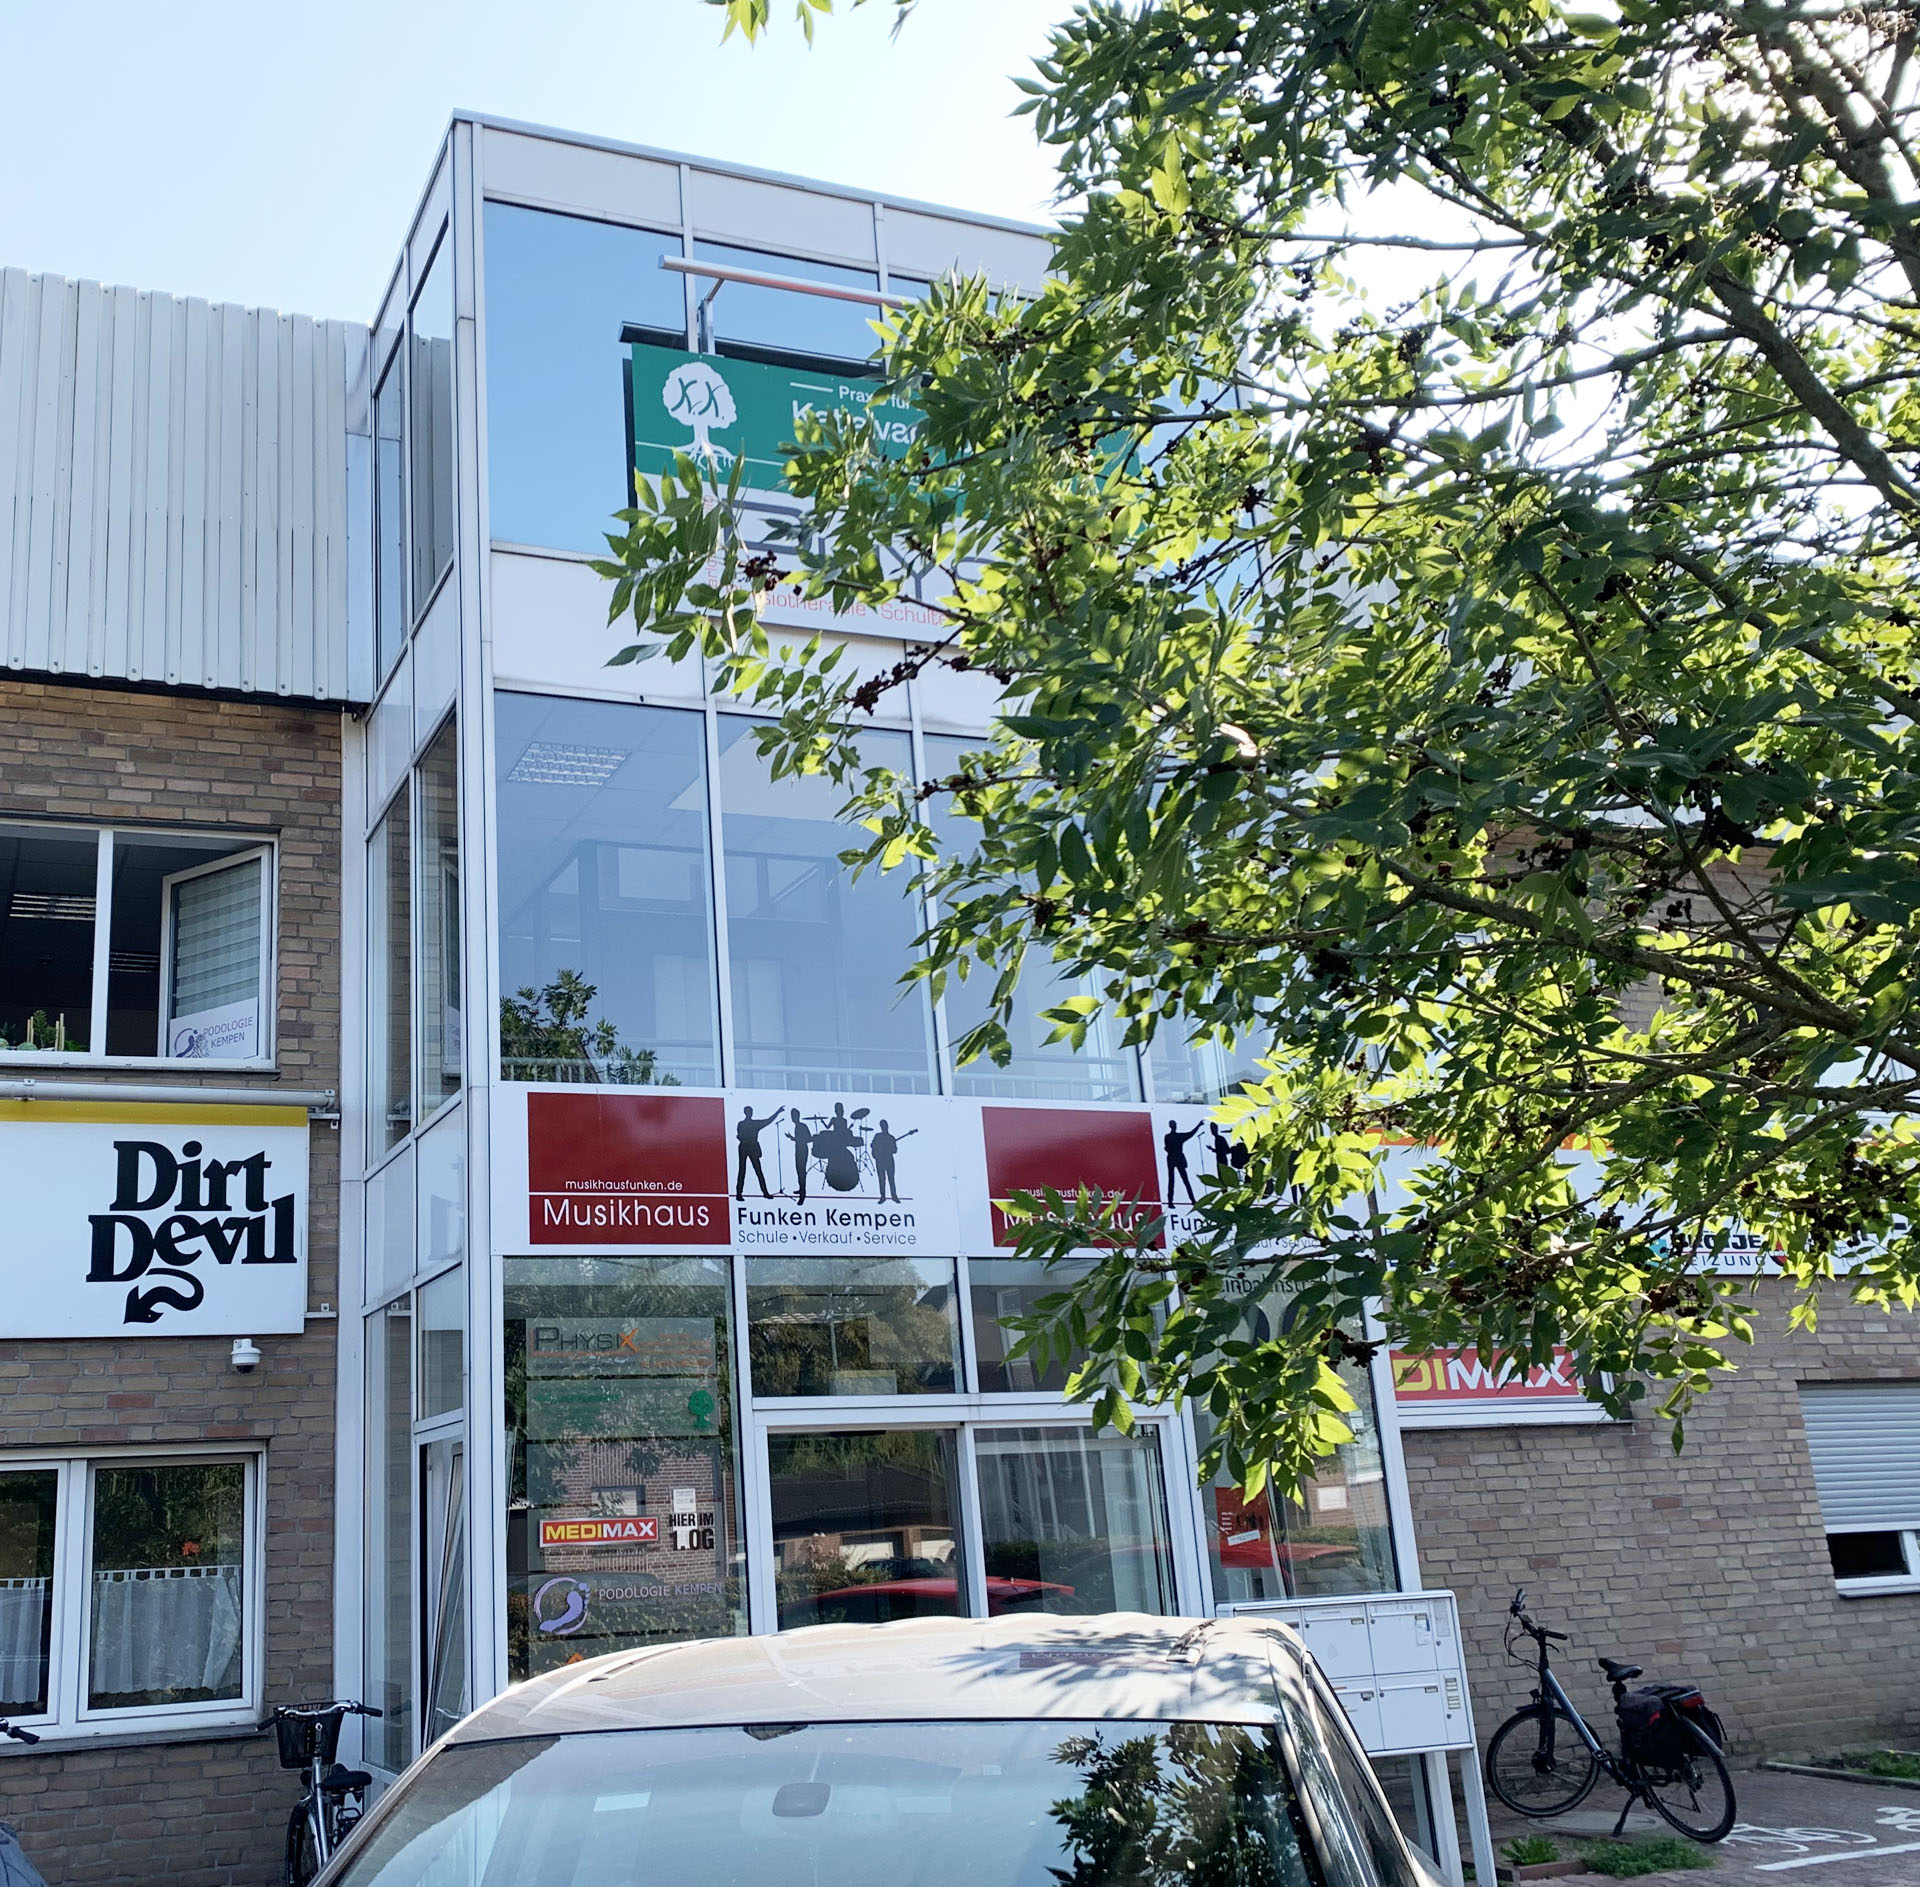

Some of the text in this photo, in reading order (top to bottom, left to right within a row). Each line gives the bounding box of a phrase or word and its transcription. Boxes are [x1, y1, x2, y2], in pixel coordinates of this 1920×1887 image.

[203, 1016, 254, 1037] PODOLOGIE
[210, 1031, 245, 1048] KEMPEN
[110, 1140, 271, 1212] Dirt
[565, 1179, 683, 1191] musikhausfunken.de
[543, 1198, 915, 1230] Musikhaus Funken Kempen
[86, 1194, 297, 1283] Devil
[738, 1230, 916, 1245] Schule Verkauf Service
[545, 1512, 714, 1541] MEDIMAX HIER IM
[599, 1582, 723, 1600] PODOLOGIE KEMPEN
